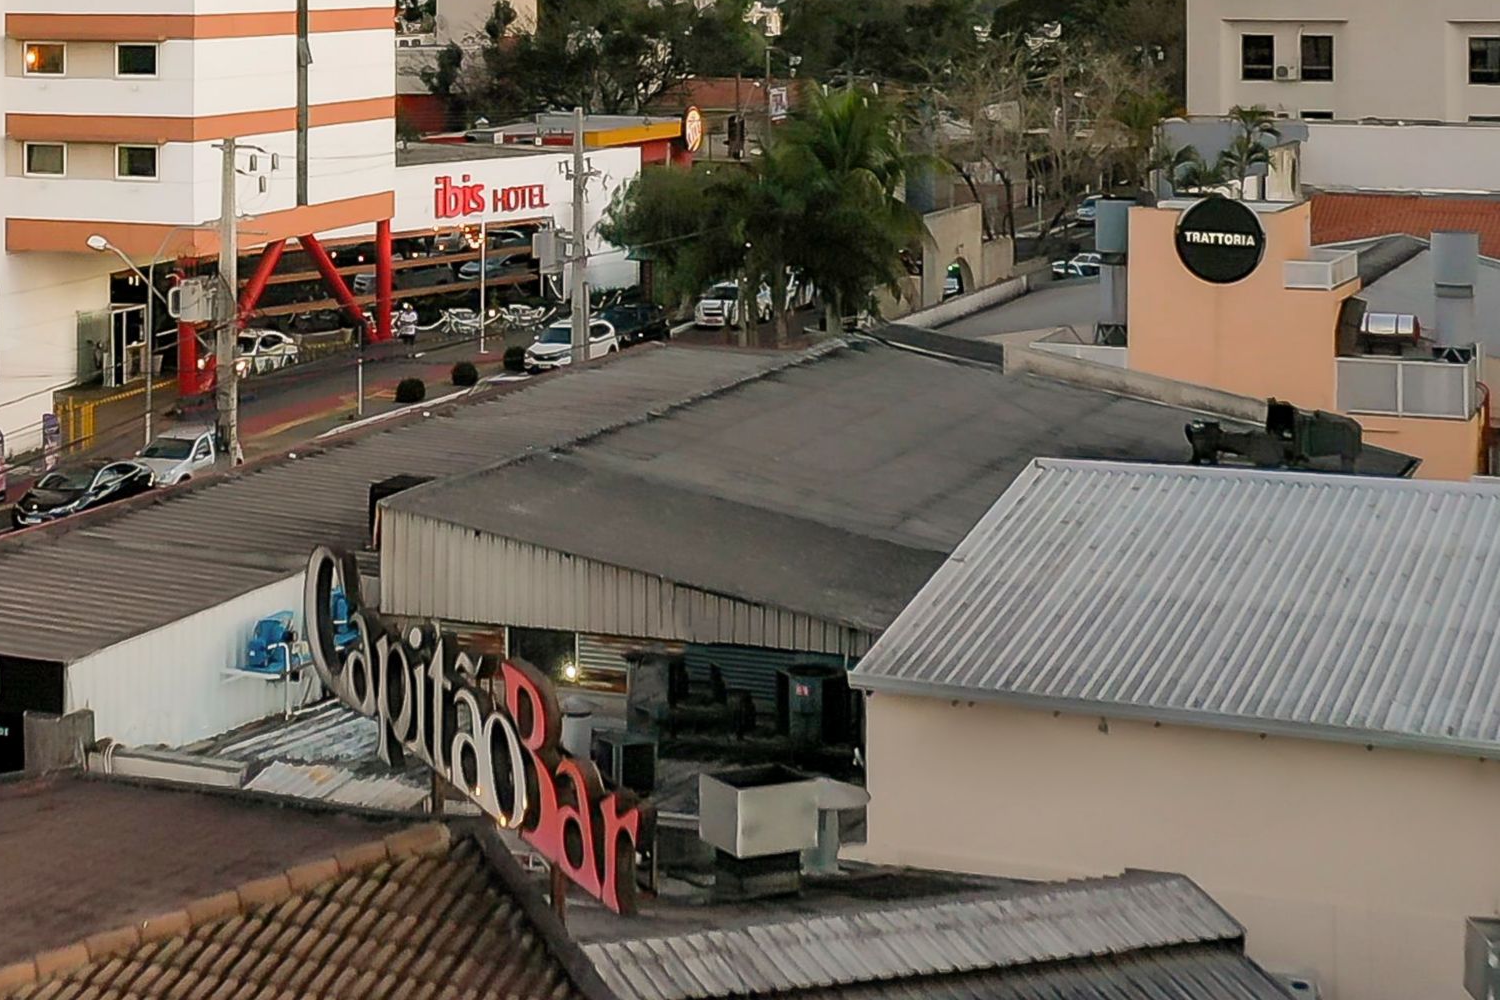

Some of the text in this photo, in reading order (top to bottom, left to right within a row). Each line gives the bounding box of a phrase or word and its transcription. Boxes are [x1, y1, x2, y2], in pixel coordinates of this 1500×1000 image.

[435, 174, 550, 218] ibis HOTEL
[1184, 231, 1256, 246] TRATTORIA
[305, 547, 639, 914] Capitão Bar
